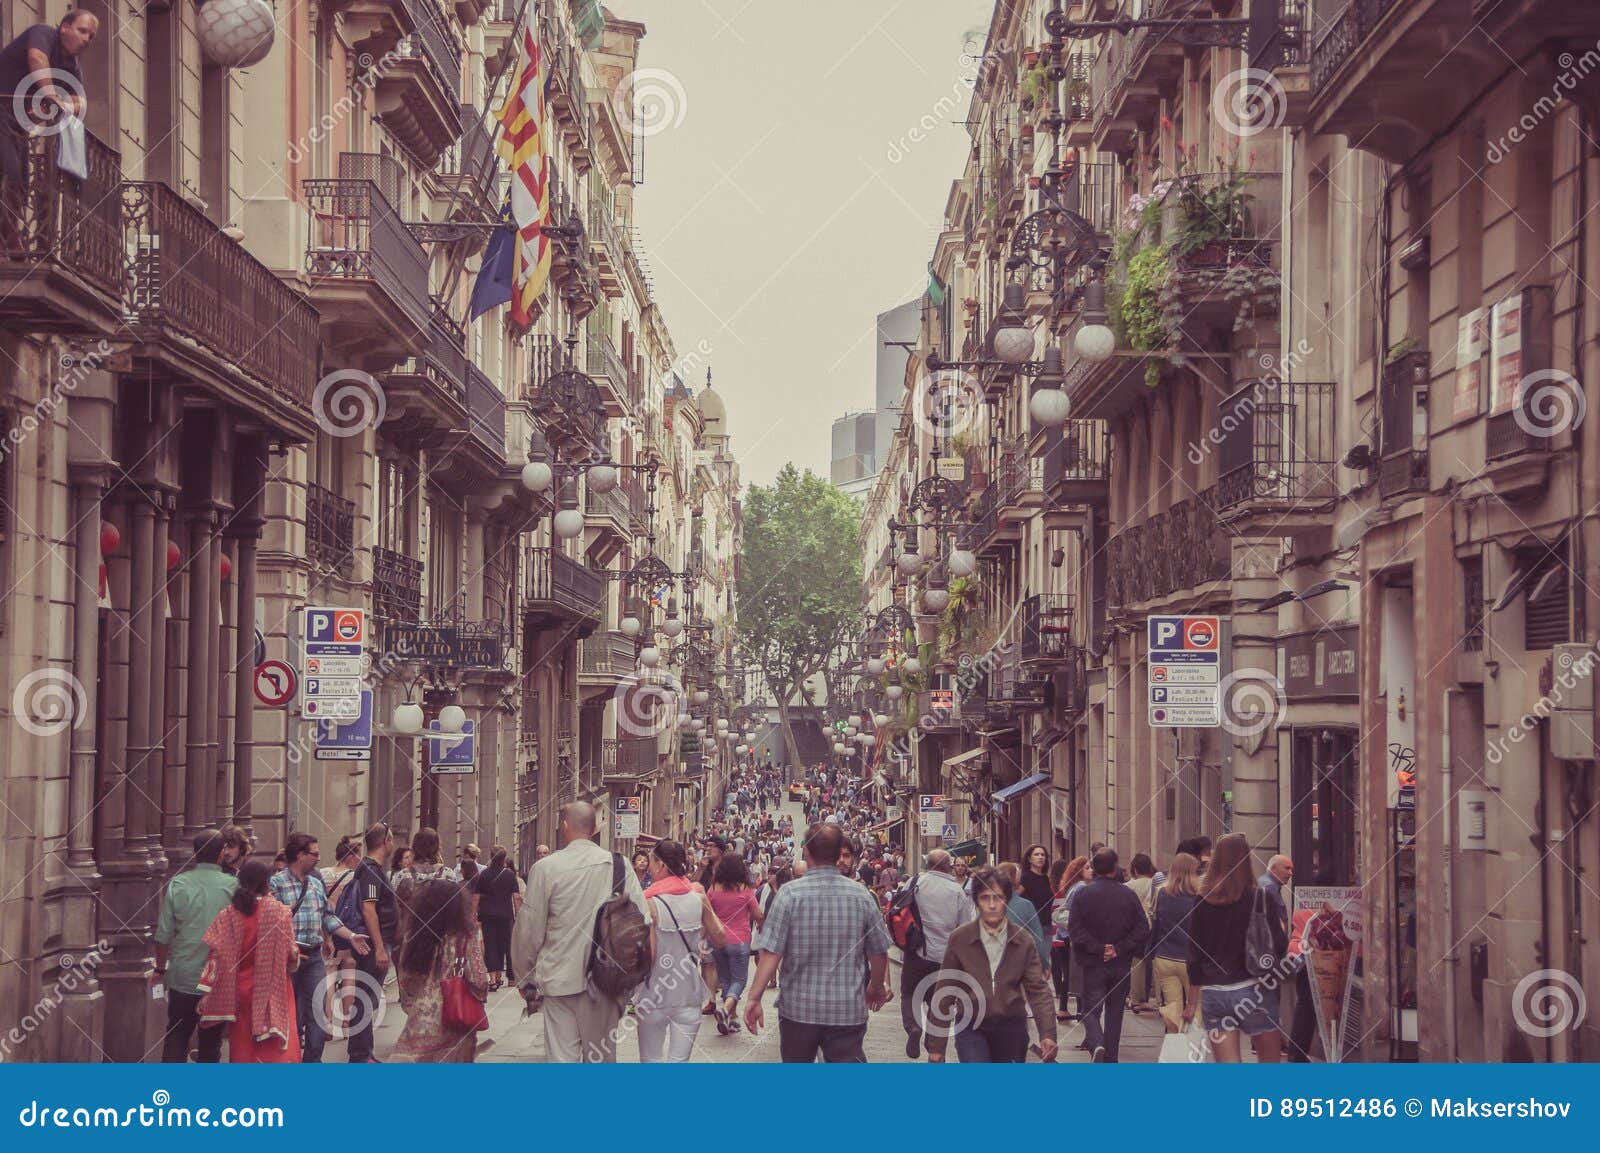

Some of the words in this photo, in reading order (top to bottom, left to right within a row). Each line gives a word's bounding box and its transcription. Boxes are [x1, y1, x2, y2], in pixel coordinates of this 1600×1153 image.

[313, 614, 329, 638] P
[1157, 622, 1177, 646] P
[1154, 689, 1165, 701] P
